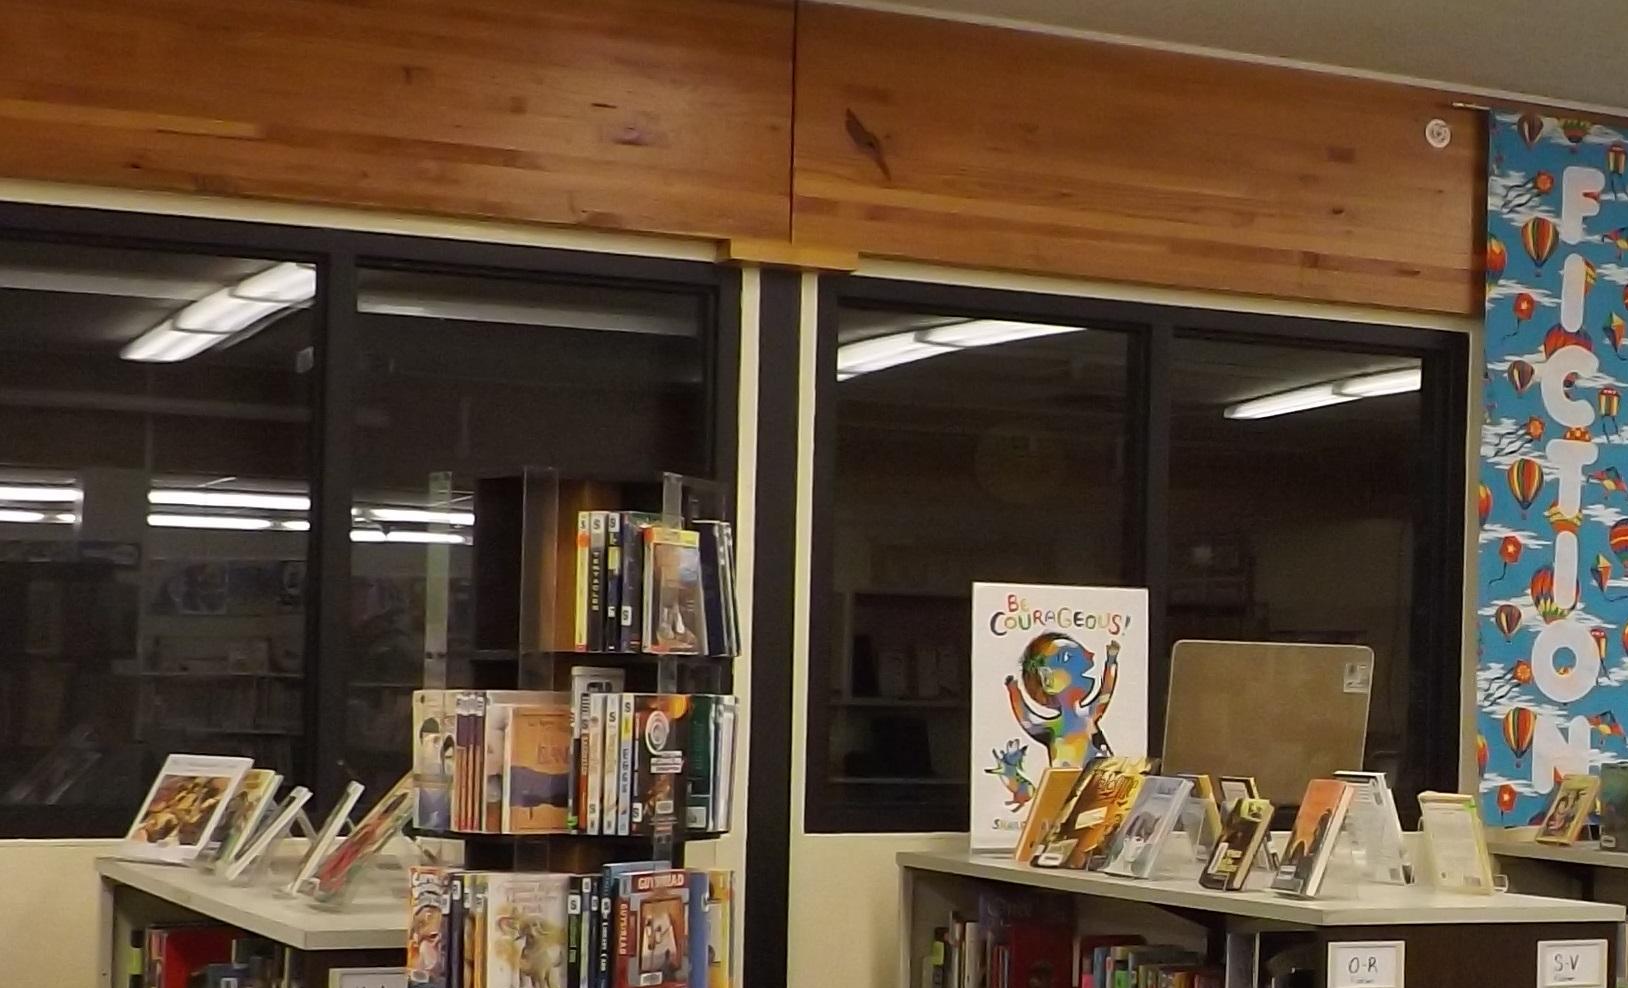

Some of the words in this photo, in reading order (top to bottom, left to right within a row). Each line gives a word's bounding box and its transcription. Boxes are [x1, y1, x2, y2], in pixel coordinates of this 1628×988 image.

[1531, 166, 1606, 794] FICTION
[570, 899, 577, 910] S
[1347, 955, 1378, 975] O-R
[1553, 953, 1580, 972] S-V
